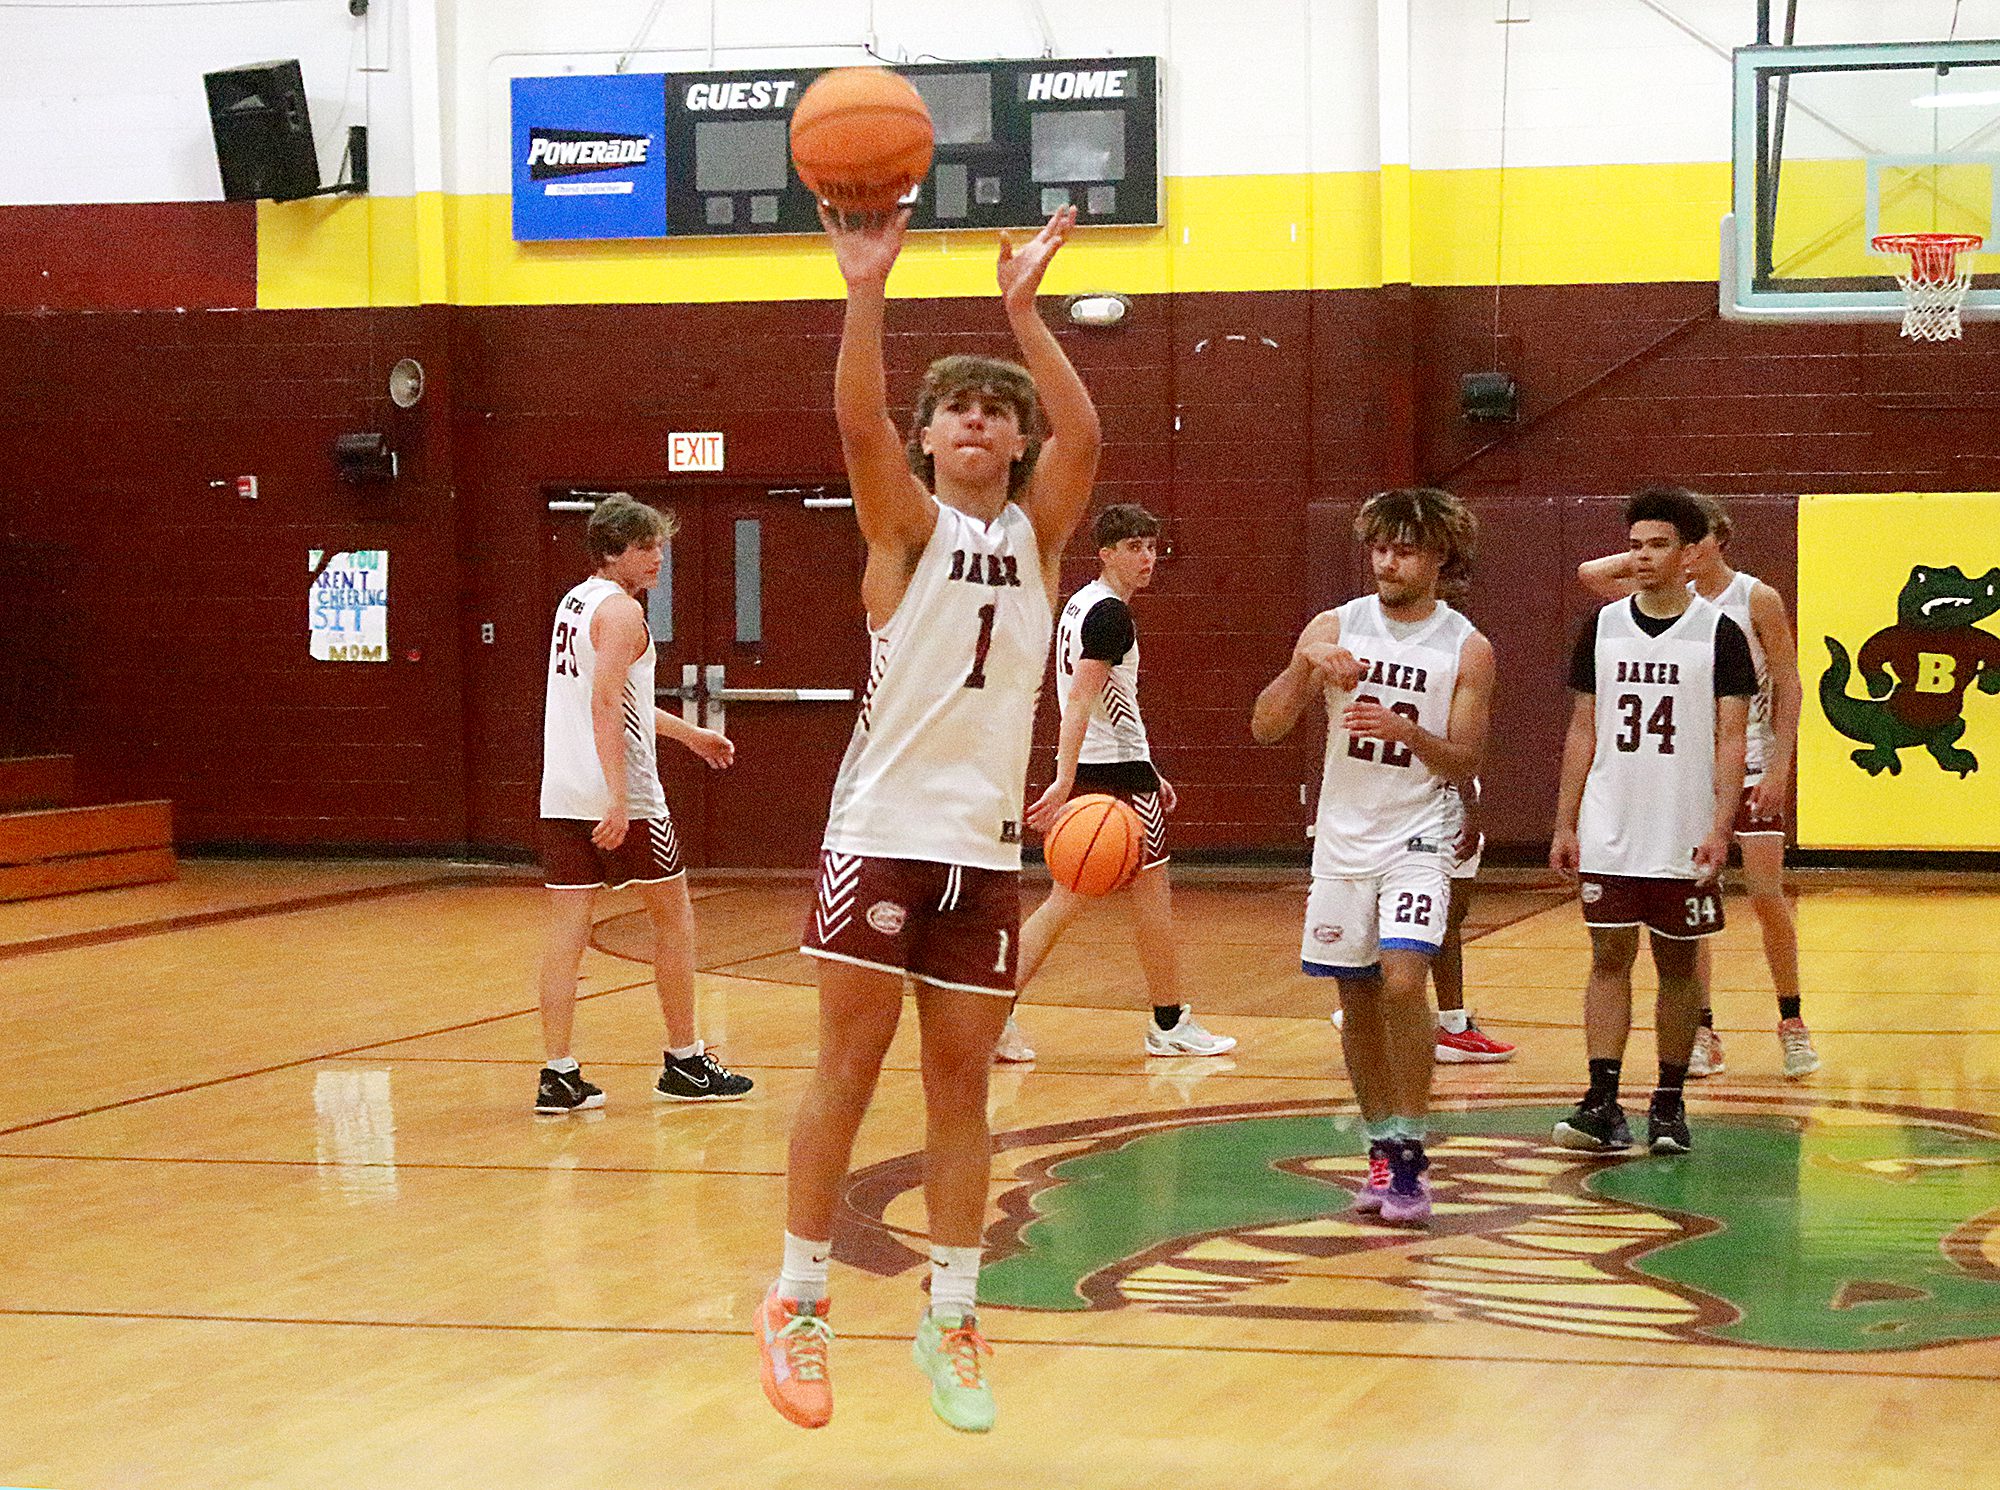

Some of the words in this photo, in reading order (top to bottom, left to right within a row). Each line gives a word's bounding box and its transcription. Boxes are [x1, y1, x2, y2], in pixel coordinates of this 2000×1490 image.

[685, 81, 796, 111] GUEST
[1027, 70, 1128, 101] HOME
[674, 437, 720, 466] EXIT
[313, 604, 367, 632] SIT
[328, 644, 383, 660] MOM
[963, 604, 995, 689] 1
[1616, 661, 1680, 685] BAKER
[1915, 652, 1956, 694] B
[1615, 693, 1676, 755] 34
[1394, 891, 1432, 926] 22
[1684, 895, 1716, 927] 34
[993, 929, 1009, 973] 1
